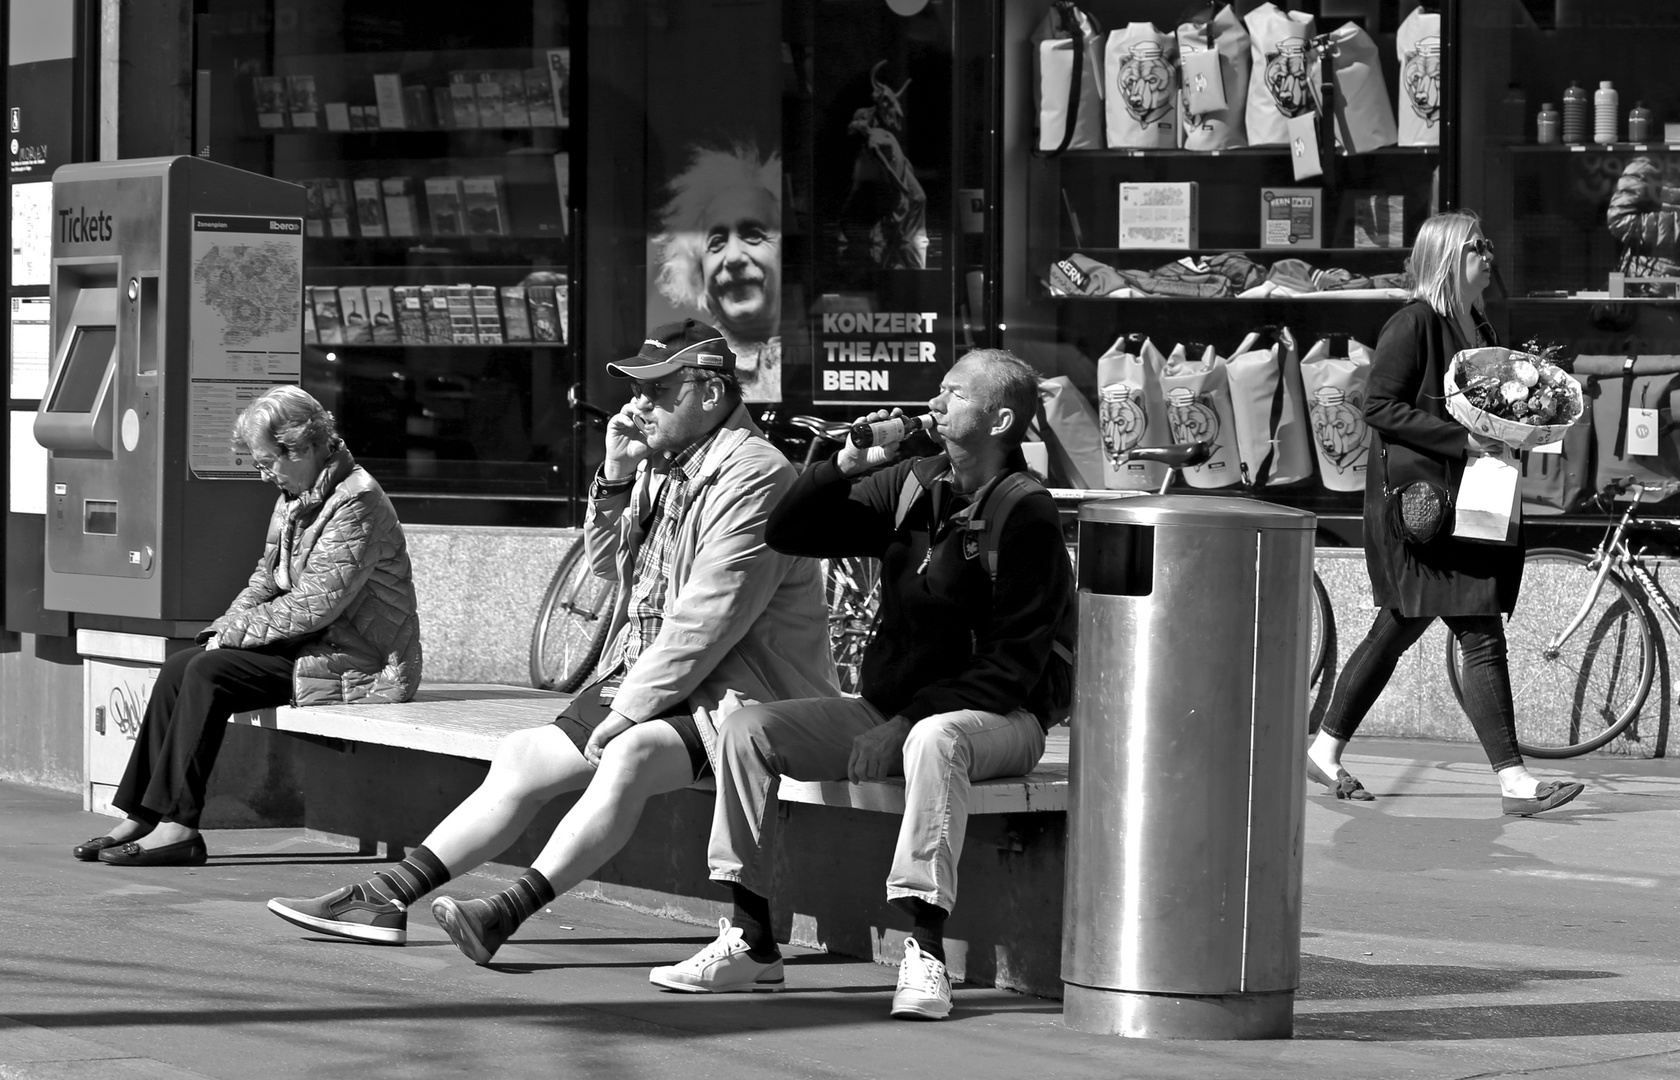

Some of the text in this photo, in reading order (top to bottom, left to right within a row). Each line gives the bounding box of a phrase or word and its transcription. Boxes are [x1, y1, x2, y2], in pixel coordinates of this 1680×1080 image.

[59, 206, 112, 243] Tickets
[197, 221, 228, 229] Zonenplan
[823, 312, 938, 334] KONZERT
[823, 341, 937, 363] THEATER
[823, 370, 889, 391] BERN
